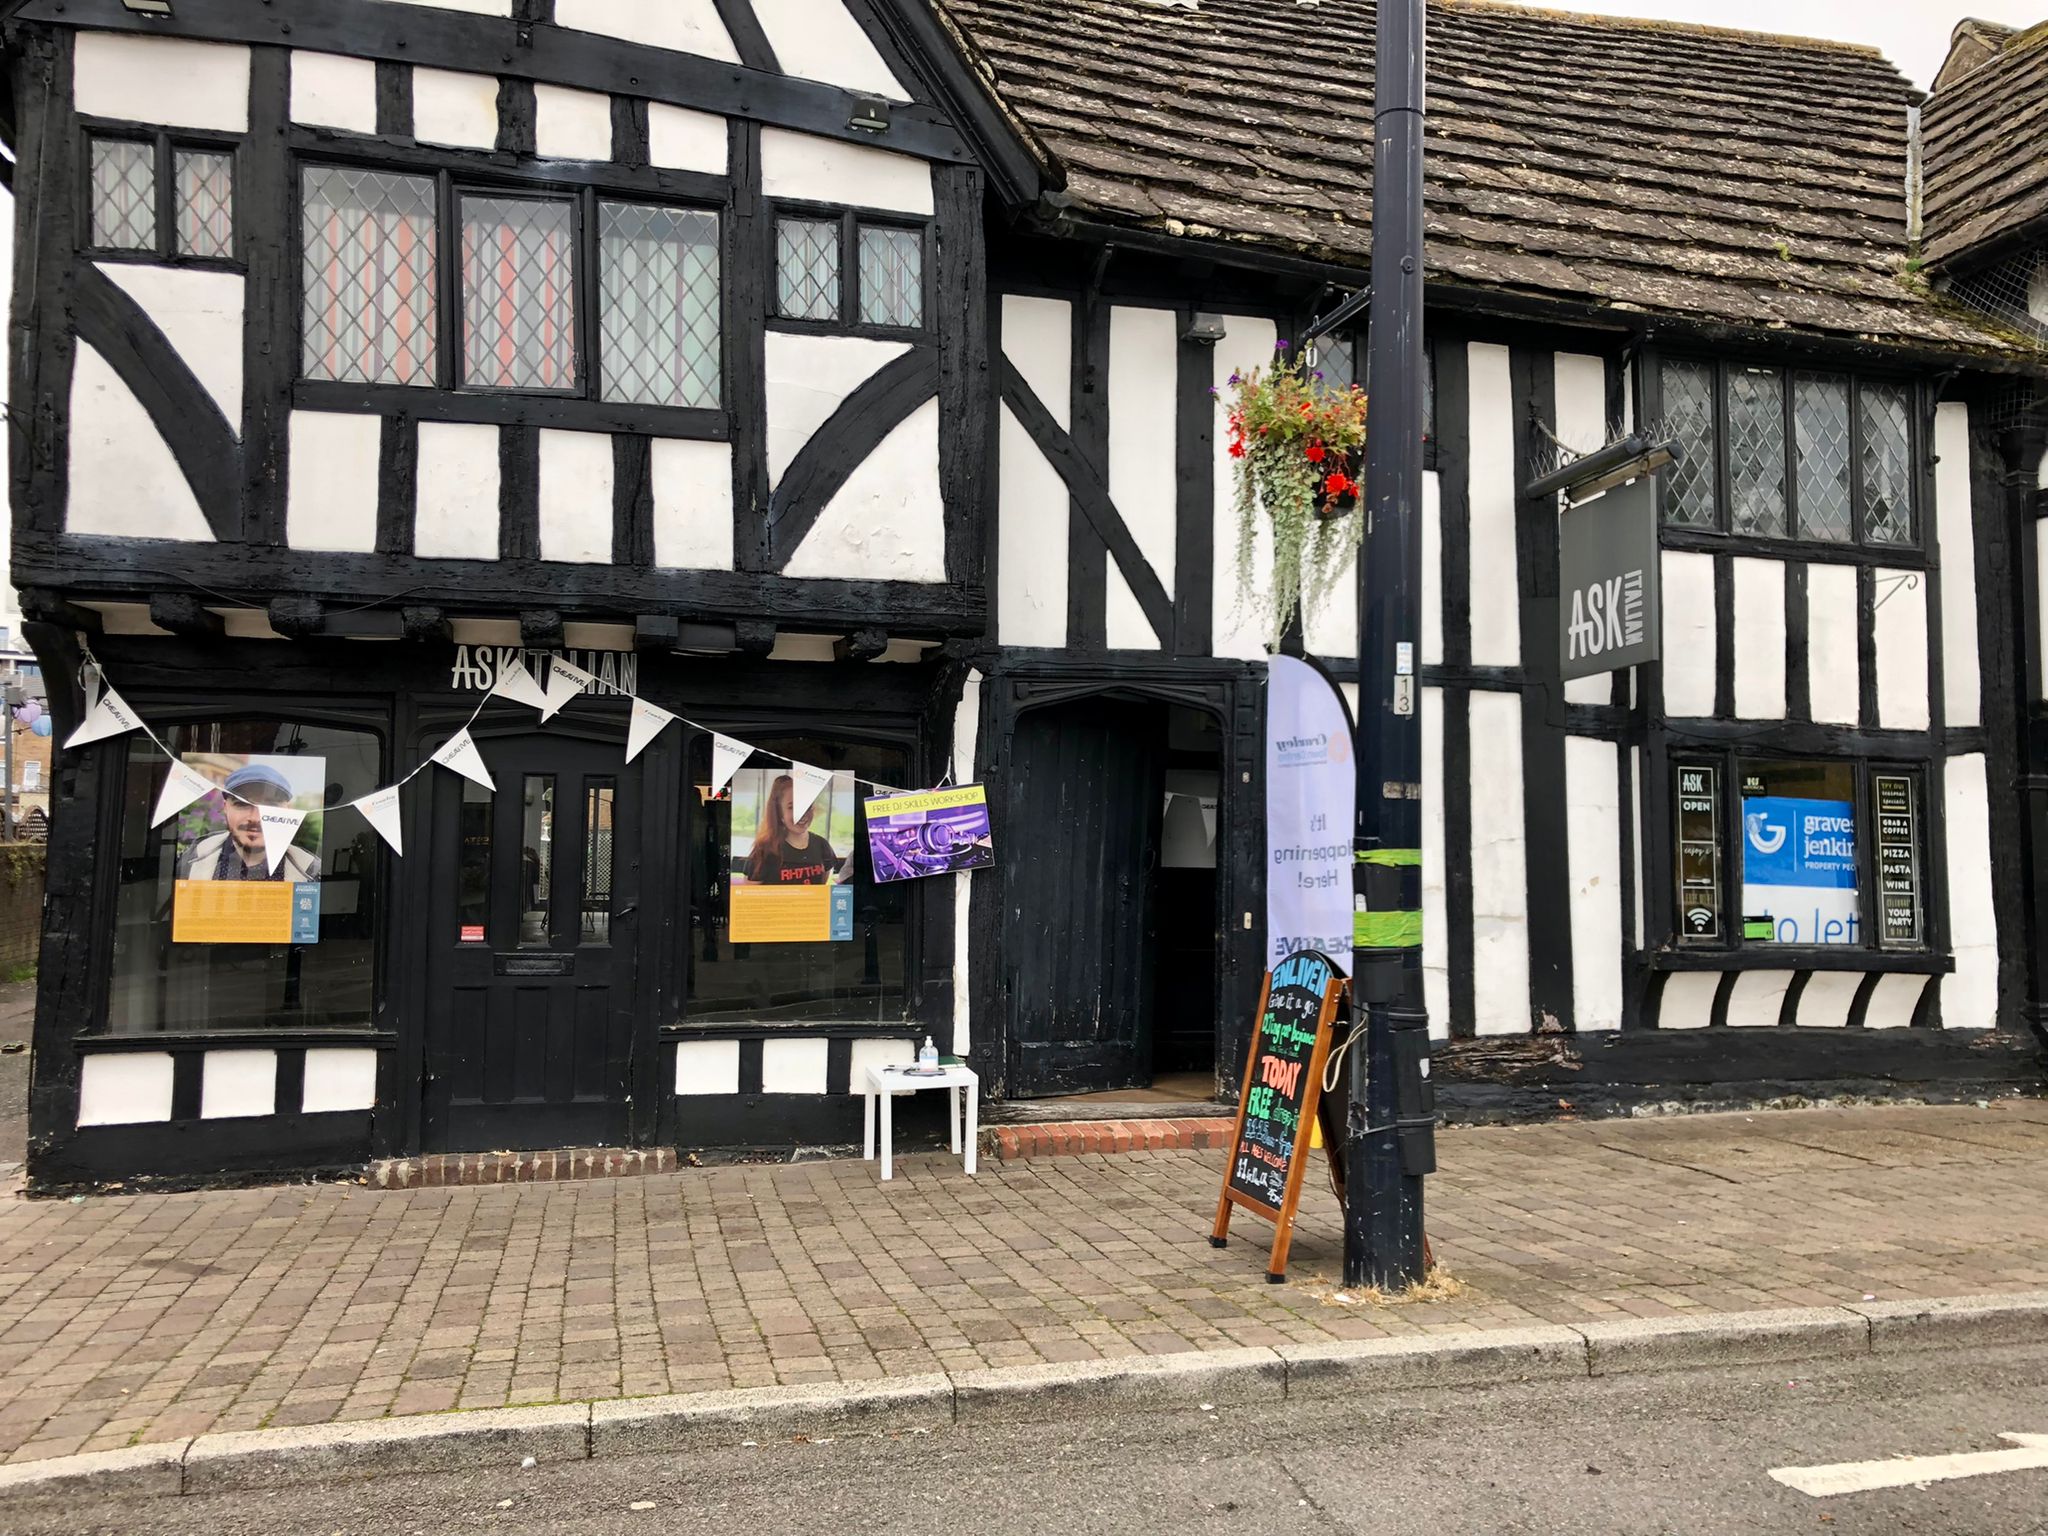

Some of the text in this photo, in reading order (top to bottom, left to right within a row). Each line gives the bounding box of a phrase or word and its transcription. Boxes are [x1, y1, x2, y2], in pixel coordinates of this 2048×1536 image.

[1624, 569, 1643, 646] ITALIAN
[1568, 576, 1624, 660] ASK
[451, 645, 513, 690] ASK
[102, 699, 131, 731] CREATIVE
[1682, 773, 1704, 793] ASK
[872, 791, 979, 814] FREE DJ SKILLS WORKSHOP
[1683, 801, 1711, 812] OPEN
[261, 814, 300, 827] CREATIVE
[1882, 819, 1901, 827] GRAB
[1882, 827, 1909, 835] COFFEE
[1883, 849, 1910, 859] PIZZA
[1805, 861, 1840, 871] PROPERTY
[1883, 865, 1911, 875] PASTA
[1886, 881, 1910, 890] WINE
[1887, 917, 1912, 926] PARTY
[1888, 908, 1911, 917] YOUR
[1814, 908, 1860, 944] let
[1270, 957, 1331, 999] ENLIVEN
[1285, 992, 1295, 1010] it
[1261, 1055, 1302, 1101] TODAY
[1247, 1086, 1275, 1120] FREE
[1250, 1143, 1265, 1159] AGES
[1263, 1150, 1288, 1172] WELCOME
